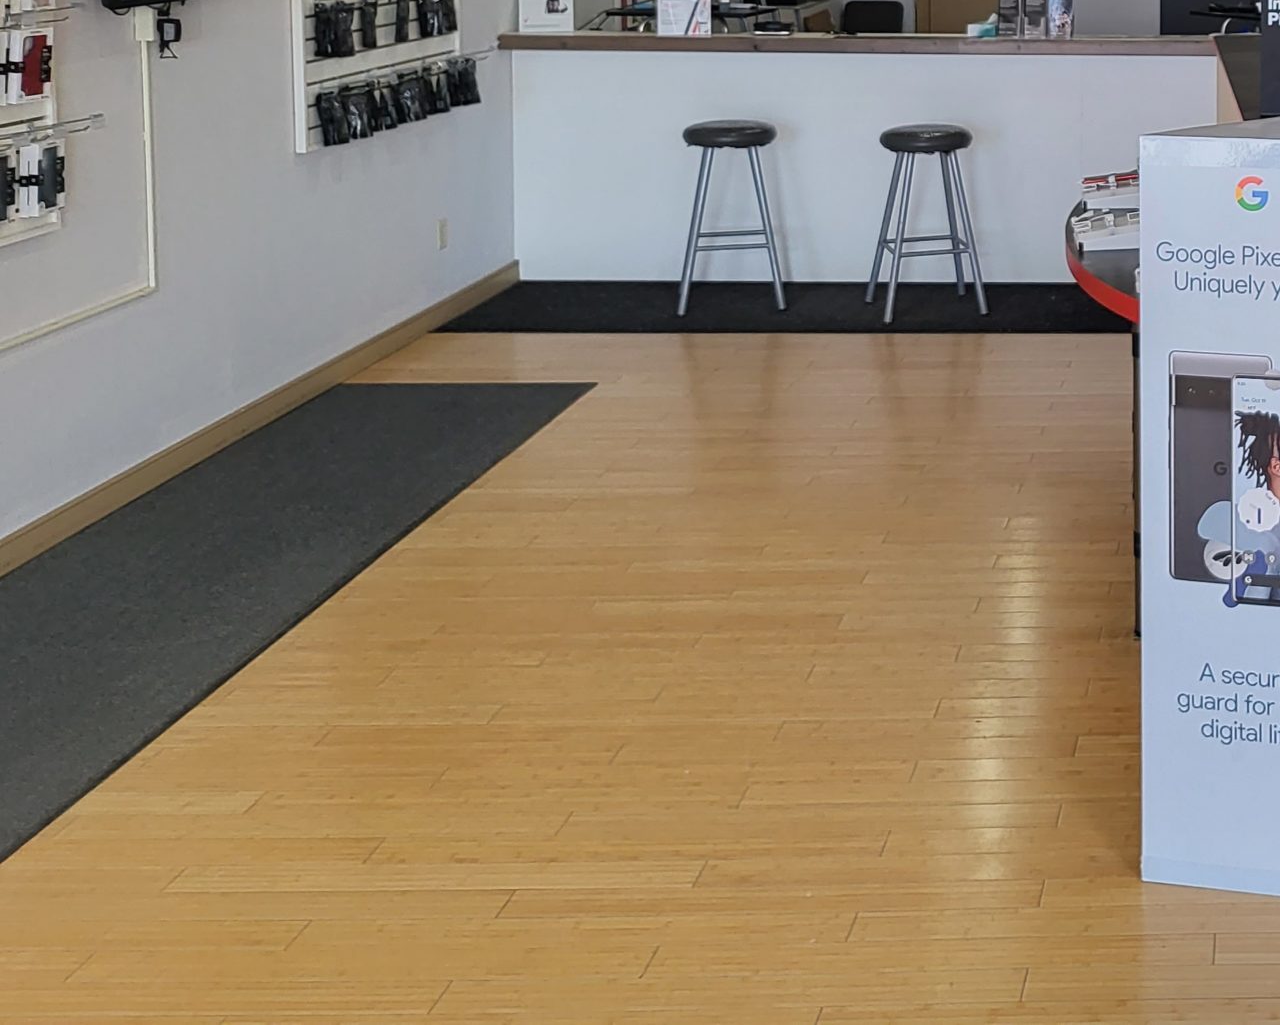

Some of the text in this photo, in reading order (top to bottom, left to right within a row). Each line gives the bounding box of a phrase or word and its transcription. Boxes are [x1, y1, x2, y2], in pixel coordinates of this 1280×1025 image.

[1156, 241, 1235, 270] Google
[1174, 270, 1266, 301] Uniquely
[1199, 662, 1216, 683] A
[1177, 692, 1238, 713] guard
[1244, 694, 1276, 715] for
[1201, 718, 1263, 745] digital
